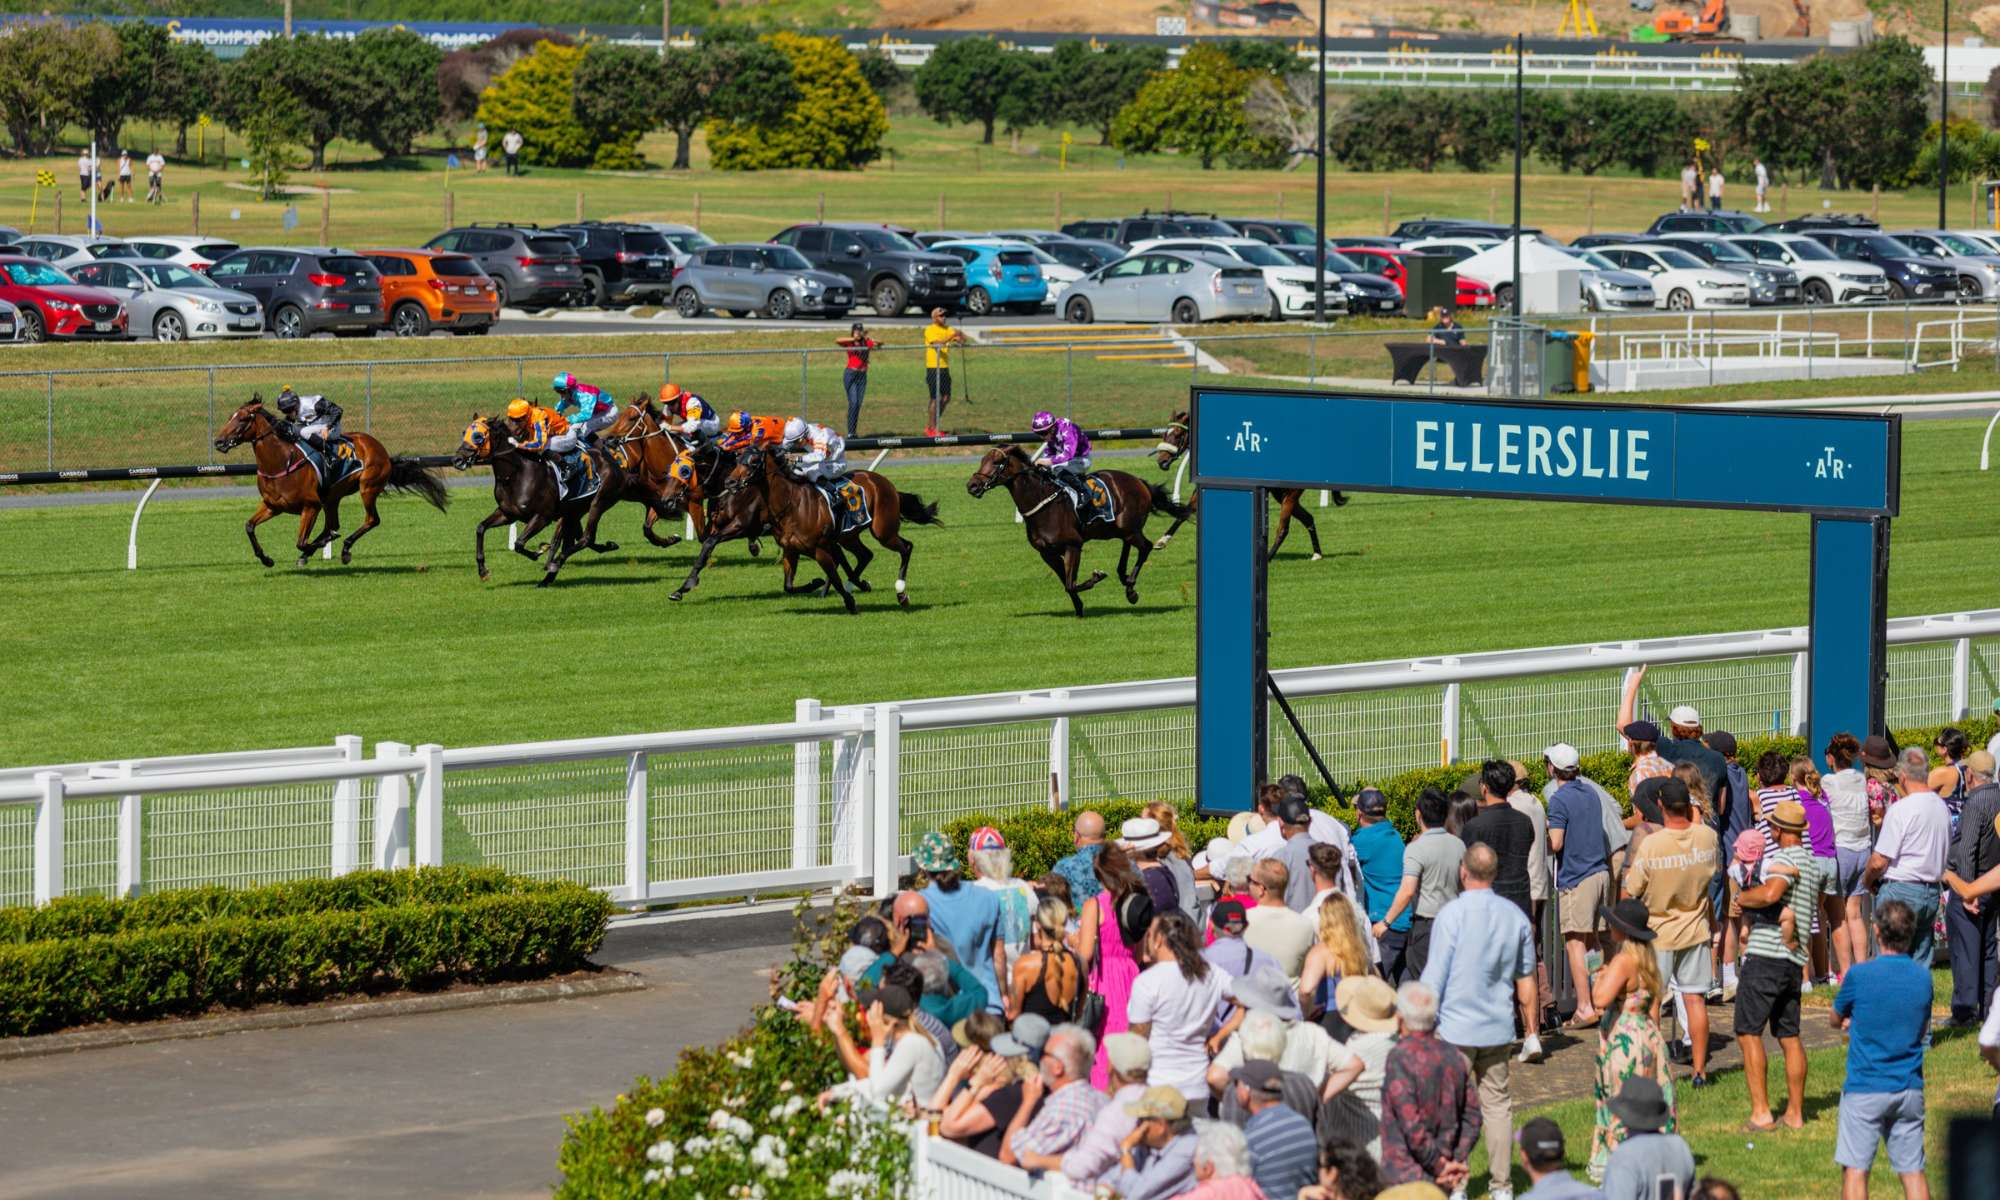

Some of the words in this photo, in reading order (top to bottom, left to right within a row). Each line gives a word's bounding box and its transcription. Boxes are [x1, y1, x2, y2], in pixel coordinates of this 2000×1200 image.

[1415, 420, 1650, 481] ELLERSLIE
[59, 470, 88, 478] CAMBRIDGE
[841, 482, 862, 512] 8
